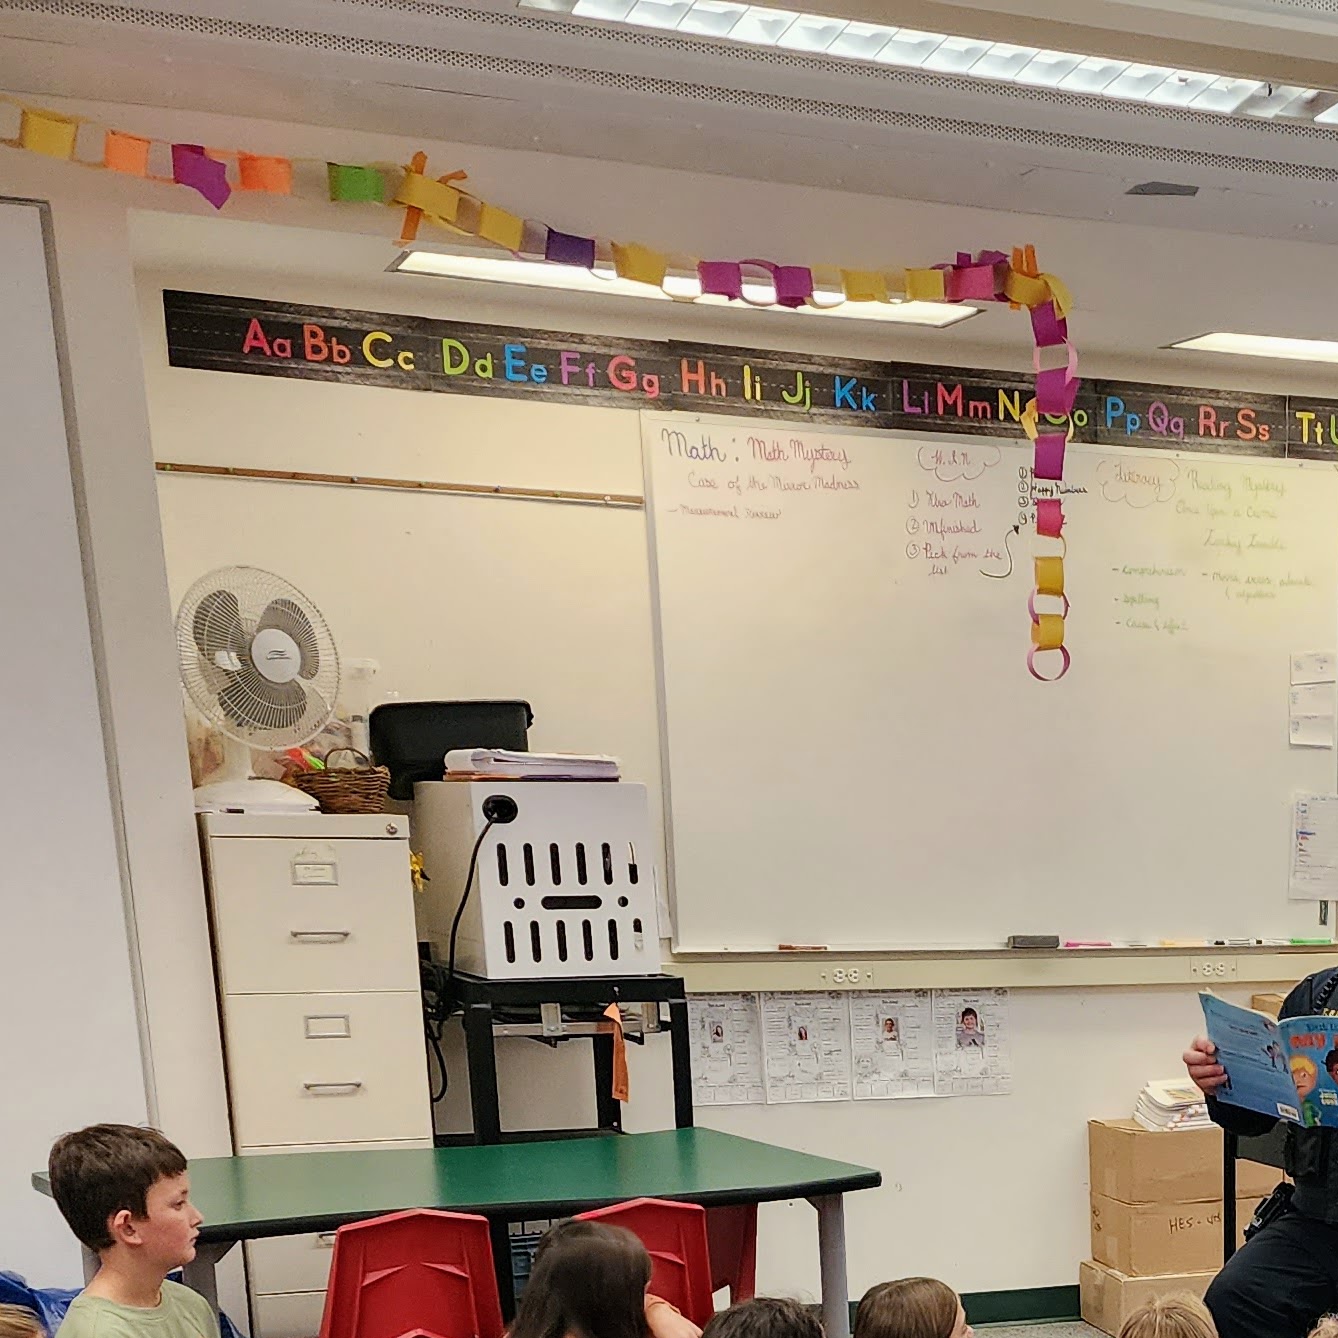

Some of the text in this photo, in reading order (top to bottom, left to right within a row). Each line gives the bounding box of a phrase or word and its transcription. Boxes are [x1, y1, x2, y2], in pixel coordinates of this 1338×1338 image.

[242, 318, 292, 358] Aa
[303, 324, 351, 365] Bb
[362, 332, 415, 371] Cc
[441, 338, 493, 379] Dd
[504, 344, 547, 384] Ee
[559, 351, 596, 387] Ff
[607, 355, 660, 399] Gg
[680, 358, 727, 397] Hh
[742, 365, 763, 402] Ii
[781, 371, 813, 411] Jj
[834, 375, 877, 412] Kk
[902, 379, 929, 413] Ll
[936, 382, 997, 419] Mm
[1105, 396, 1141, 435] Pp
[1148, 401, 1185, 440] Qq
[1198, 405, 1231, 440] Rr
[1236, 407, 1270, 442] Ss
[1295, 411, 1324, 446] Tt
[1169, 1216, 1194, 1234] HES
